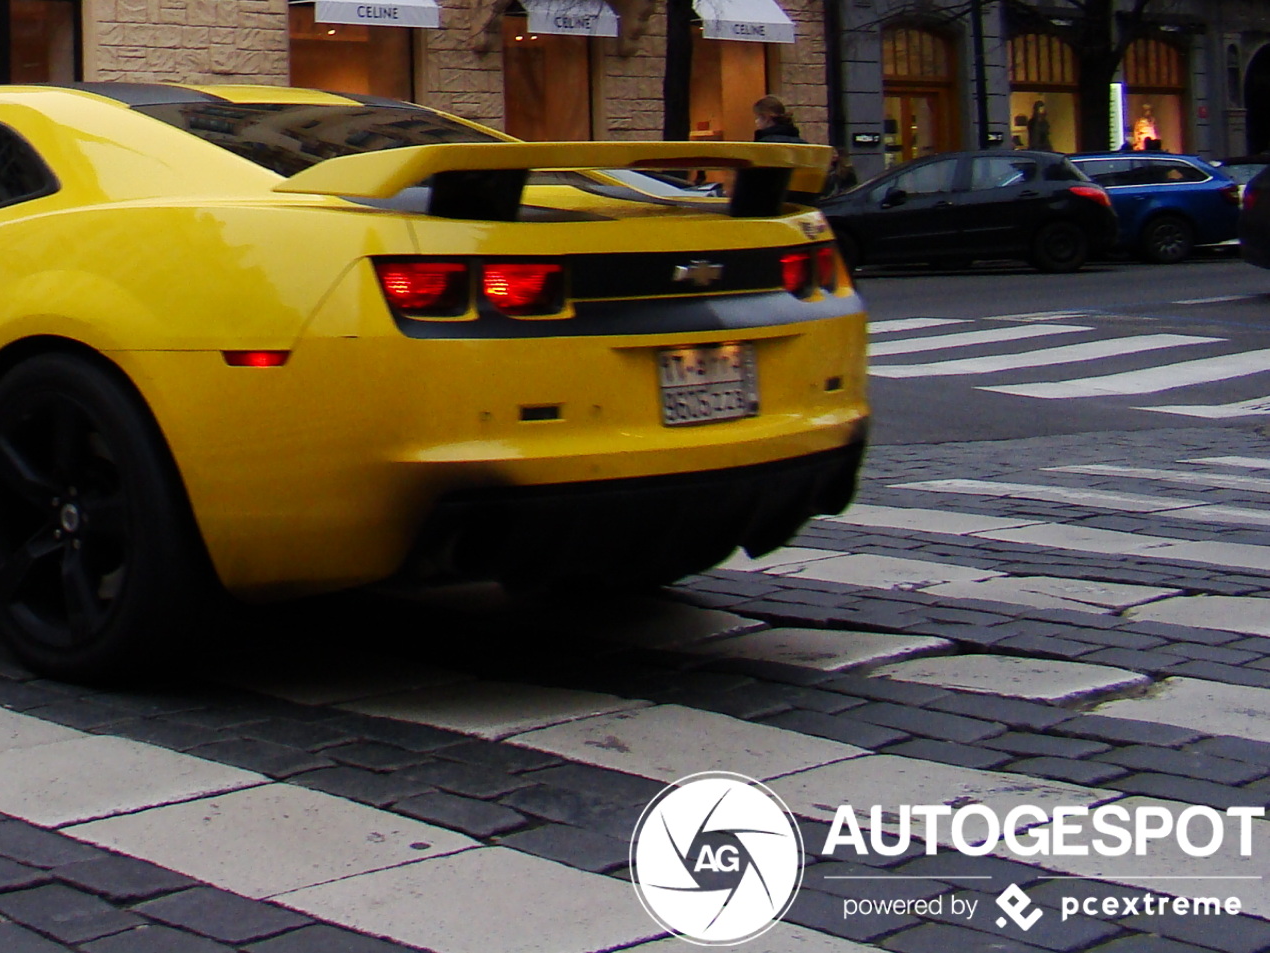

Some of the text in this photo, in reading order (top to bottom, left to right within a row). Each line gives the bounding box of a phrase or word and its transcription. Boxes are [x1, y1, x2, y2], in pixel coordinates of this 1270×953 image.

[356, 5, 399, 20] CELINE
[553, 16, 593, 30] CELINE
[732, 23, 766, 37] CELINE
